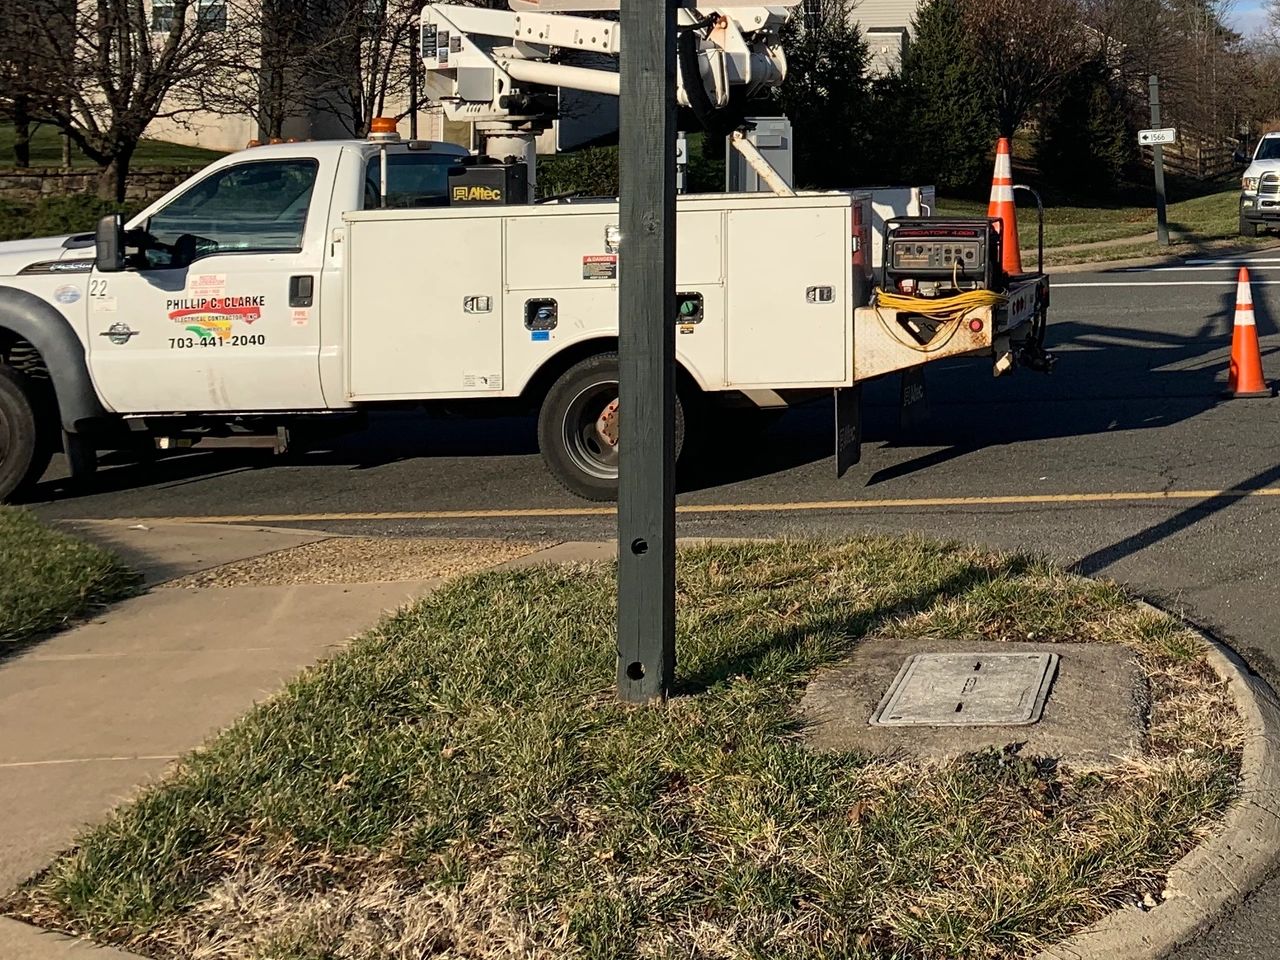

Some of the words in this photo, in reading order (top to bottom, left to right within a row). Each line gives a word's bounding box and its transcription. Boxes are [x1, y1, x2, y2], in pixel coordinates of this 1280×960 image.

[469, 186, 502, 201] Altec
[90, 280, 107, 297] 22
[166, 298, 207, 310] PHILLIP
[210, 297, 220, 309] C.
[224, 295, 266, 308] CLARKE
[174, 316, 206, 324] ELECTRICAL
[168, 334, 266, 349] 703-441-2040
